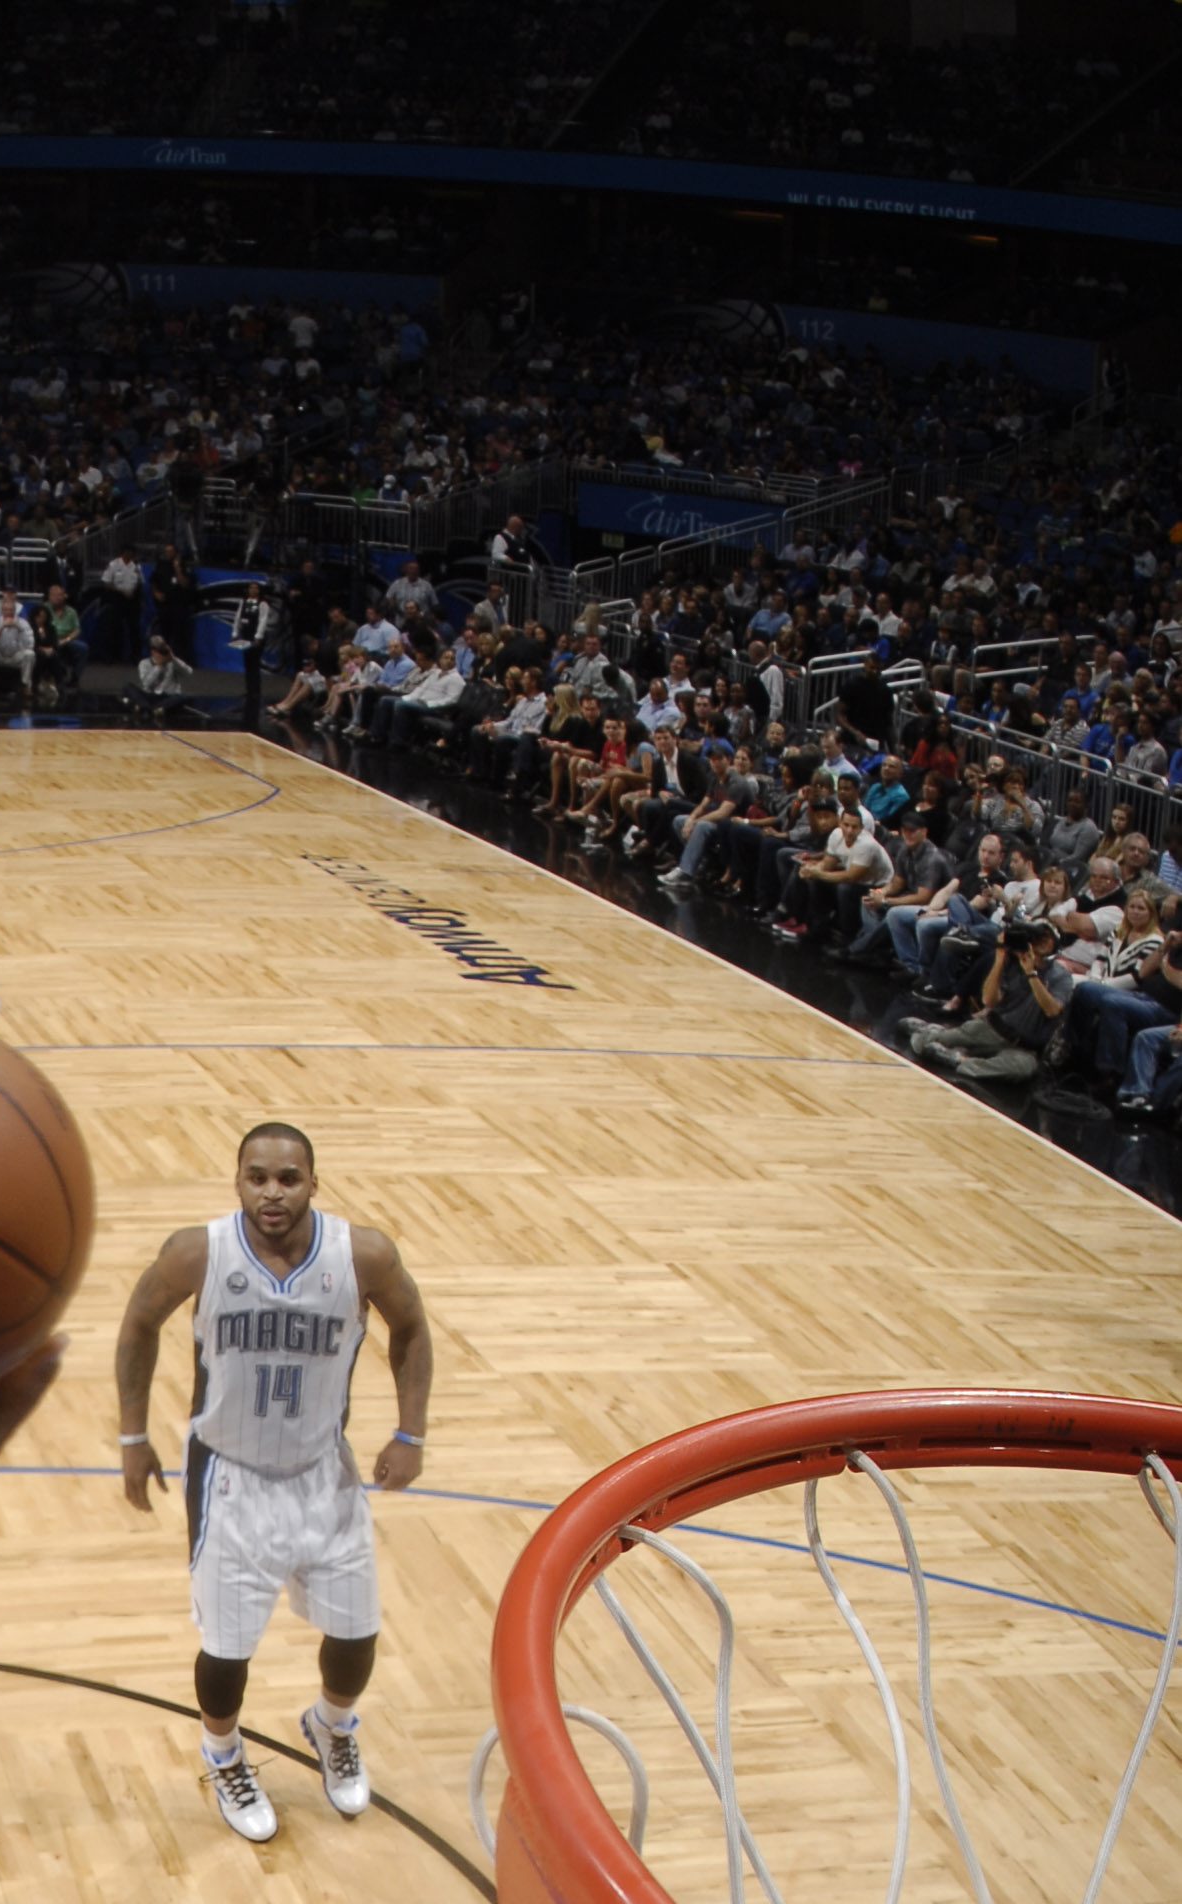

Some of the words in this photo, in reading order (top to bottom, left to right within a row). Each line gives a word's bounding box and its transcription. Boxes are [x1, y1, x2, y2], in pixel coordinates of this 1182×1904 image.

[139, 272, 176, 292] 111
[798, 318, 835, 341] 112
[215, 1307, 346, 1356] MAGIC
[253, 1364, 303, 1418] 14
